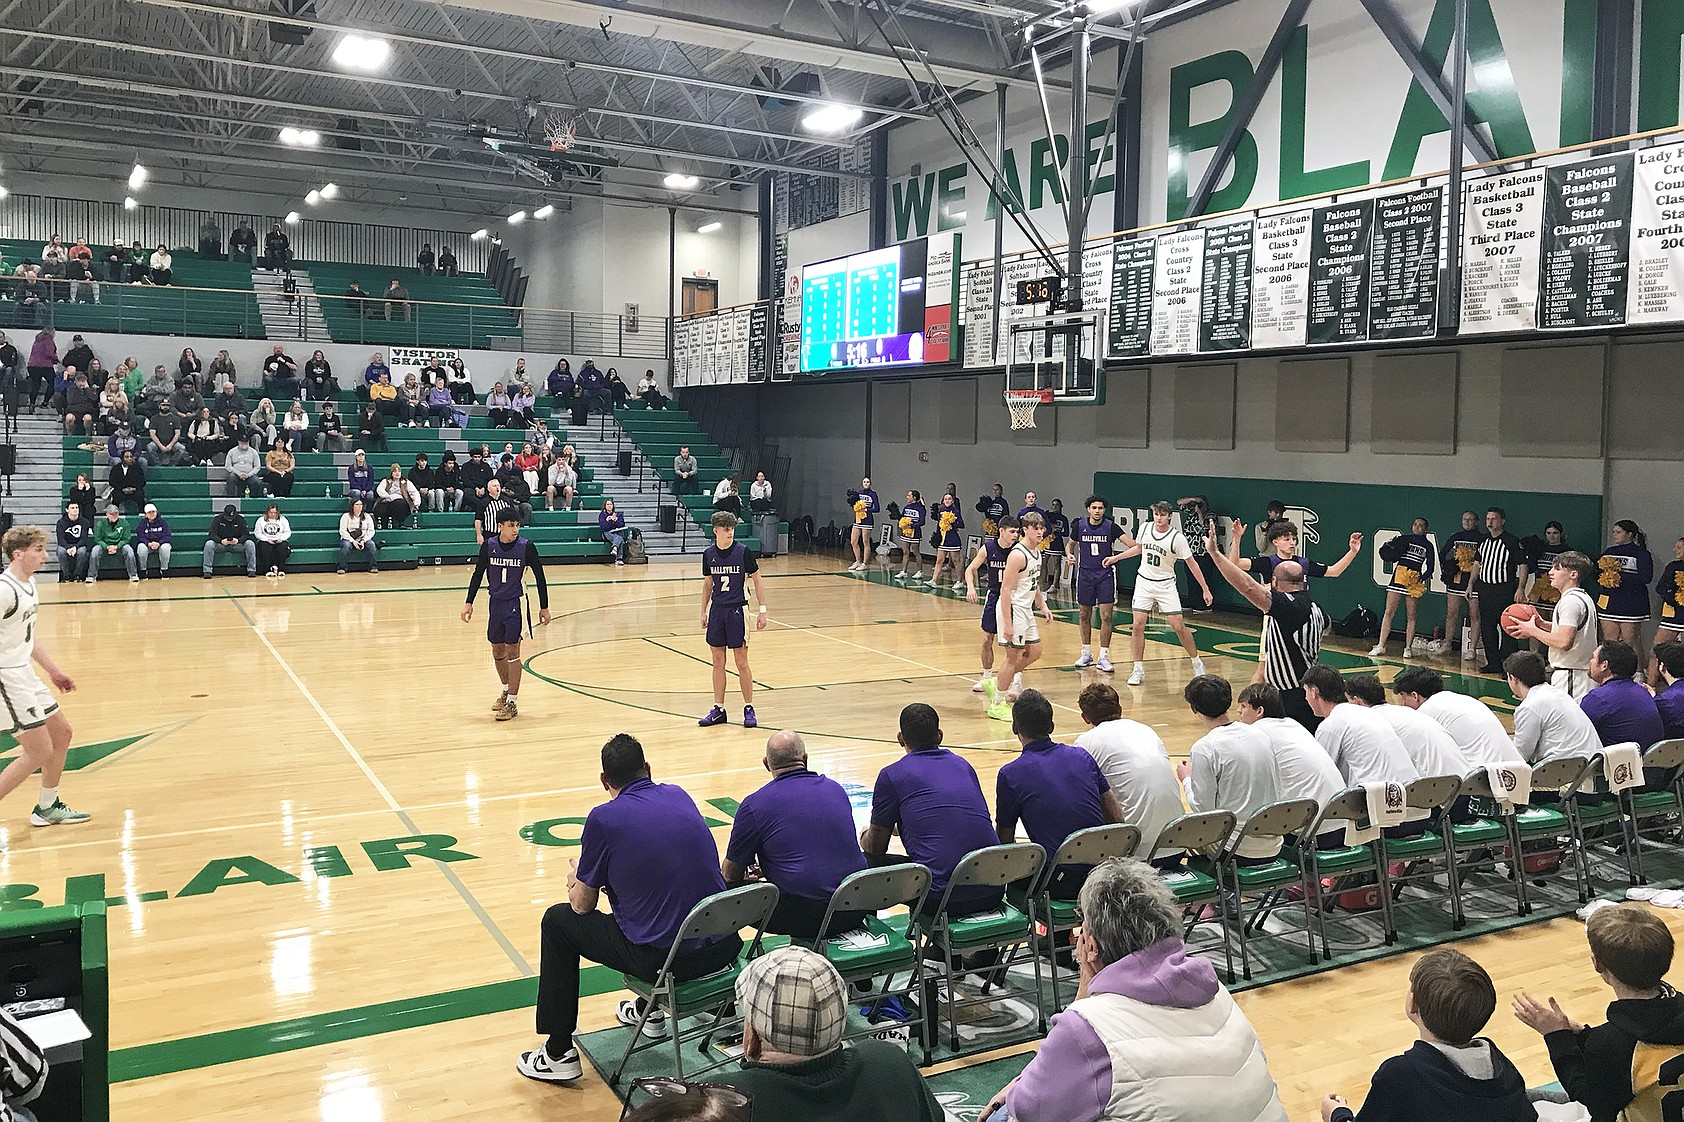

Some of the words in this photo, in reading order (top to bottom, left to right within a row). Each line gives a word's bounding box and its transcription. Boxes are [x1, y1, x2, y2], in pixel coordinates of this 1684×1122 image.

[1639, 151, 1672, 164] Lady
[1566, 165, 1616, 180] Falcons
[1663, 164, 1684, 175] Cro
[892, 162, 967, 241] WE
[984, 119, 1115, 221] ARE
[1467, 181, 1496, 193] Lady
[1499, 173, 1543, 188] Falcons
[1562, 177, 1617, 195] Baseball
[1379, 197, 1406, 208] Falcons
[1407, 190, 1439, 204] Football
[1473, 187, 1535, 205] Basketball
[1565, 195, 1598, 208] Class
[1601, 191, 1611, 202] 2
[1656, 194, 1684, 206] Clas
[1325, 208, 1361, 221] Falcons
[1383, 208, 1402, 218] Class
[1410, 202, 1433, 214] 2007
[1482, 206, 1512, 217] Class
[1515, 202, 1524, 213] 3
[1571, 207, 1605, 221] State
[1661, 209, 1684, 221] Sta
[1257, 220, 1278, 230] Lady
[1280, 215, 1311, 226] Falcons
[1323, 218, 1362, 233] Baseball
[1384, 217, 1409, 229] Second
[1410, 214, 1432, 226] Place
[1486, 218, 1518, 230] State
[1553, 219, 1623, 236] Champions
[1207, 228, 1228, 238] Falcons
[1228, 222, 1252, 234] Football
[1262, 226, 1306, 240] Basketball
[1325, 232, 1349, 243] Class
[1350, 230, 1358, 240] 2
[1637, 223, 1683, 238] Fourth
[1159, 238, 1175, 247] Lady
[1176, 234, 1204, 244] Falcons
[1227, 235, 1243, 243] Class
[1268, 240, 1290, 250] Class
[1291, 238, 1298, 247] 3
[1469, 233, 1501, 246] Third
[1504, 230, 1536, 241] Place
[1569, 233, 1604, 248] 2007
[1661, 238, 1684, 249] 20
[1090, 249, 1113, 258] Falcons
[1170, 246, 1190, 254] Cross
[1205, 248, 1221, 257] State
[1221, 243, 1252, 254] Champions
[1329, 244, 1354, 254] State
[1484, 245, 1516, 257] 2007
[1166, 256, 1193, 266] Country
[1272, 251, 1294, 261] State
[1317, 253, 1365, 267] Champions
[1084, 261, 1102, 269] Cross
[1166, 267, 1184, 276] Class
[1254, 263, 1285, 274] Second
[1287, 261, 1309, 271] Place
[1328, 265, 1353, 277] 2006
[968, 271, 980, 279] Lady
[1009, 272, 1030, 280] Softball
[1169, 277, 1187, 286] State
[1268, 274, 1292, 284] 2006
[973, 278, 993, 286] Softball
[1025, 281, 1049, 300] 5:16
[1084, 290, 1099, 298] State
[1155, 288, 1180, 298] Second
[1181, 286, 1200, 295] Place
[1167, 297, 1187, 306] 2006
[966, 305, 984, 313] Second
[392, 349, 456, 359] VISITOR
[391, 357, 456, 367] SEATNG
[1091, 543, 1099, 556] 0
[1143, 543, 1168, 557] FALCONS
[1146, 553, 1161, 567] 20
[501, 568, 507, 583] 1
[720, 576, 730, 592] 2
